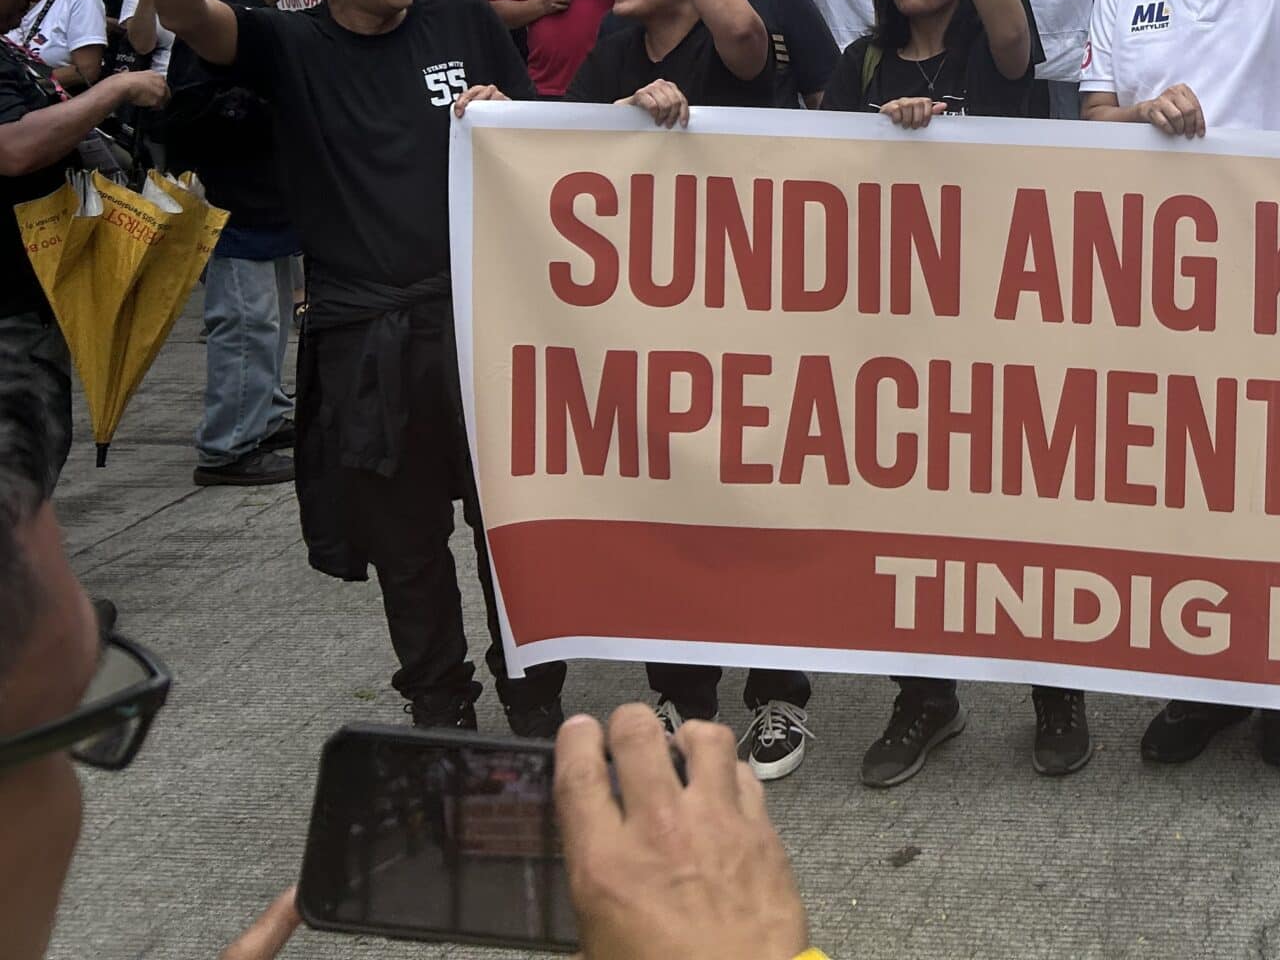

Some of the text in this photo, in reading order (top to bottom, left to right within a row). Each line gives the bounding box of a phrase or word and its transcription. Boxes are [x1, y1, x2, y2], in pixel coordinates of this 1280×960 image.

[1130, 22, 1169, 32] PARTYLIST
[1131, 1, 1170, 26] ML
[424, 68, 468, 107] 55
[548, 170, 963, 318] SUNDIN
[994, 188, 1219, 333] ANG
[874, 554, 1232, 656] TINDIG
